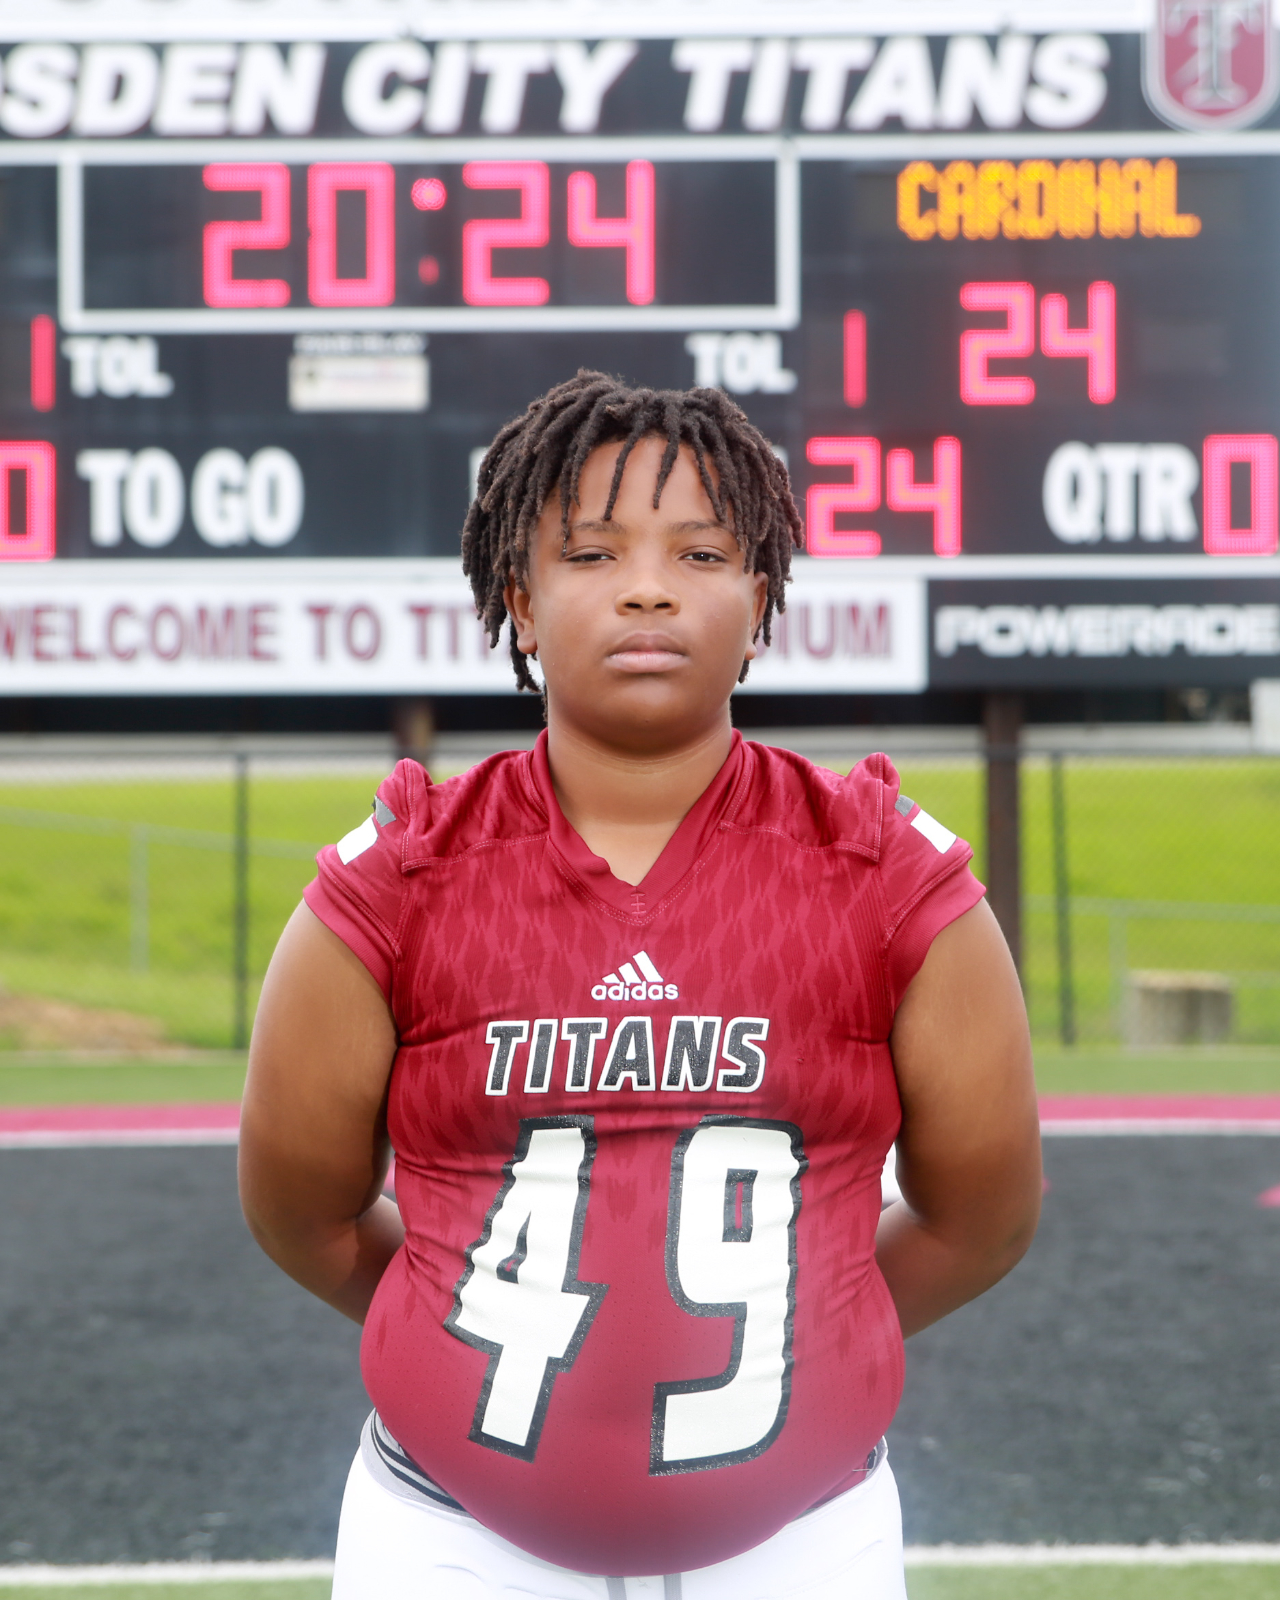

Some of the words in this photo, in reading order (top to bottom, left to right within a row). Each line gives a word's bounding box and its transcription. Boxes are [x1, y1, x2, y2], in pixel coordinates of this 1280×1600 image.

[0, 41, 326, 138] SDEN
[343, 40, 640, 136] CITY
[670, 34, 1111, 133] TITANS
[202, 160, 656, 308] 20:24
[896, 157, 1201, 240] CARDINAL
[61, 336, 174, 398] TOL
[685, 333, 797, 394] TOL
[959, 281, 1117, 405] 24
[76, 447, 185, 548] TO
[191, 446, 305, 548] GO
[806, 435, 962, 558] 24
[1042, 441, 1199, 544] QTR
[1203, 434, 1279, 556] 0
[0, 604, 279, 662] WELCOME
[306, 604, 382, 661] TO
[935, 604, 1279, 657] POWERADE
[591, 980, 679, 1002] adidas
[485, 1016, 770, 1096] TITANS
[443, 1115, 809, 1476] 49
